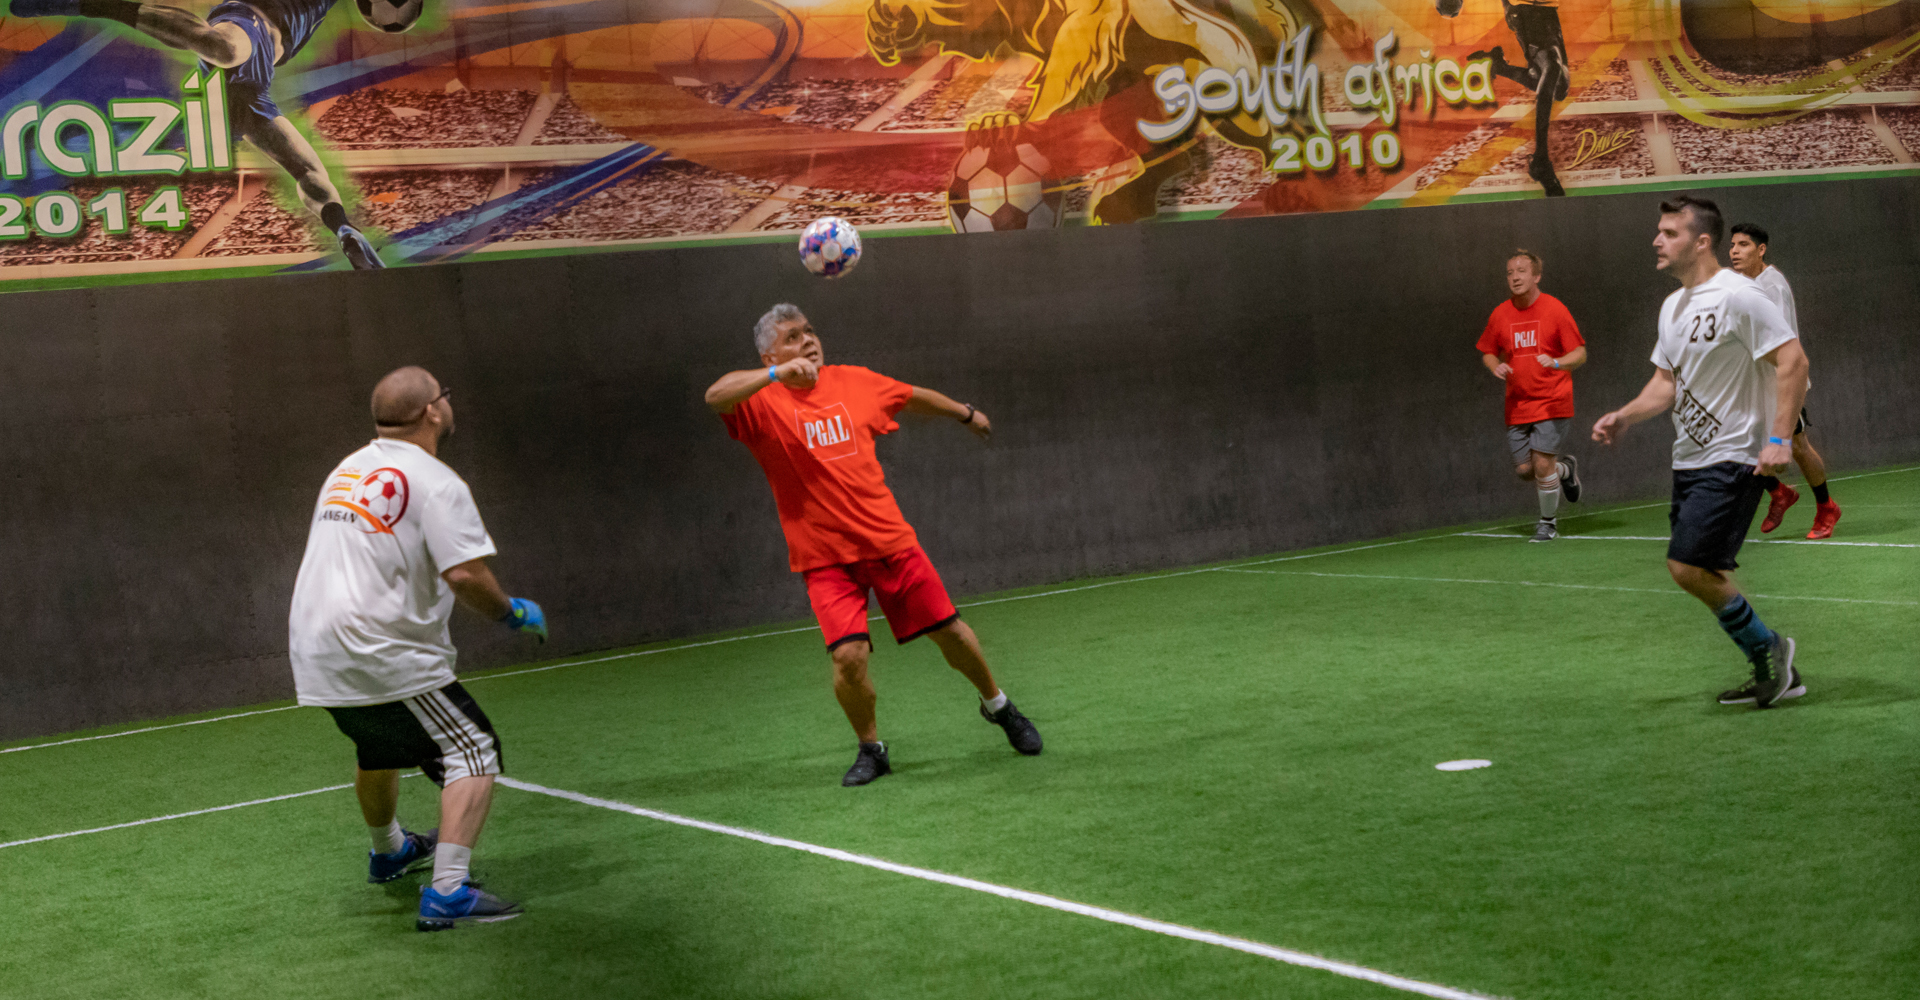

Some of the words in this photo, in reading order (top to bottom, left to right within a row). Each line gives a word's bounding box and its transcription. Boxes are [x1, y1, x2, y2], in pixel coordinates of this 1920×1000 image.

[1345, 28, 1495, 125] africa
[0, 70, 231, 177] razil
[1271, 134, 1400, 170] 2010
[0, 190, 187, 235] 2014
[1689, 313, 1716, 343] 23
[803, 415, 850, 449] PGAL
